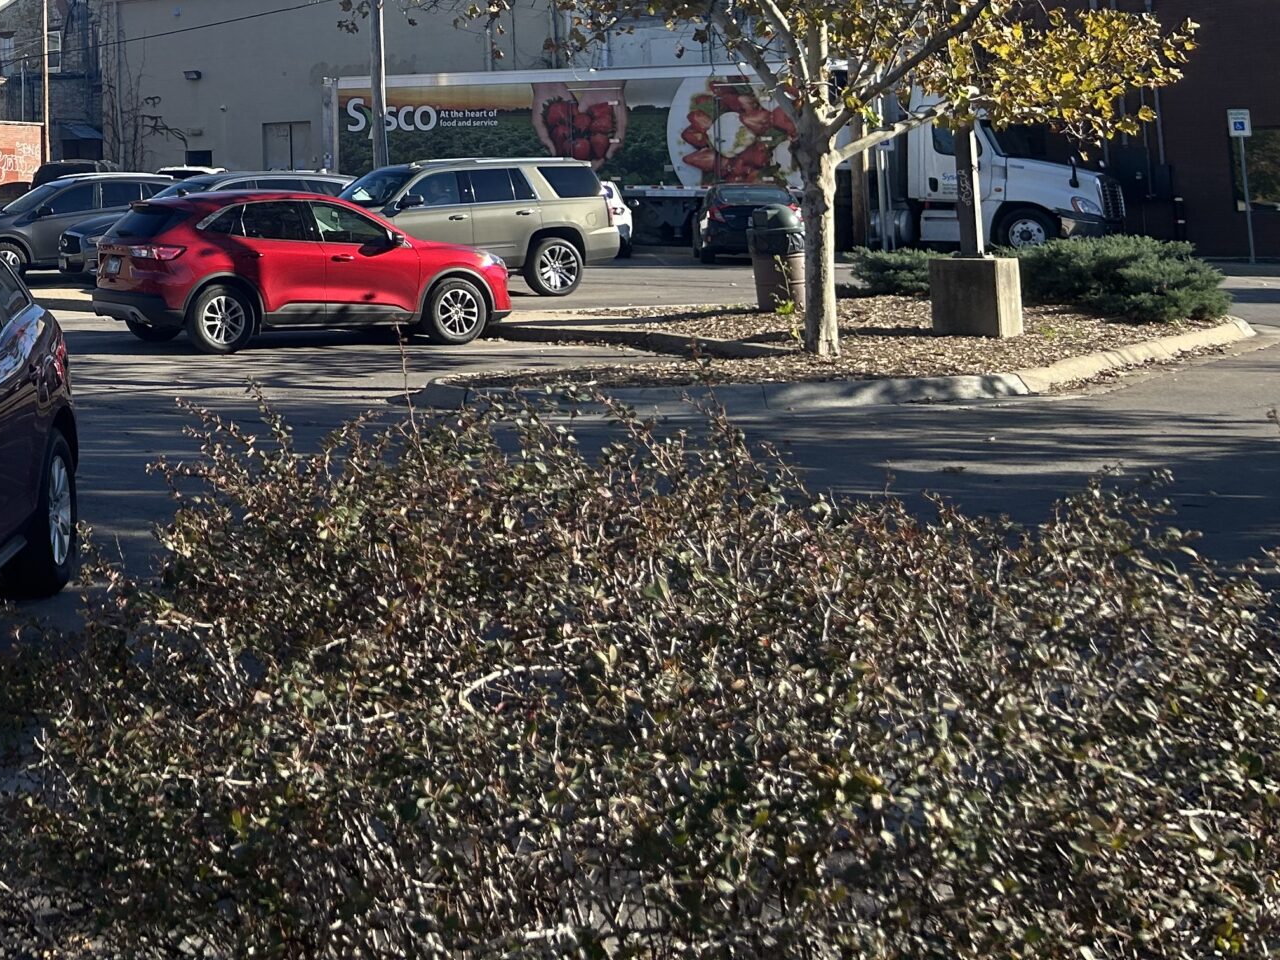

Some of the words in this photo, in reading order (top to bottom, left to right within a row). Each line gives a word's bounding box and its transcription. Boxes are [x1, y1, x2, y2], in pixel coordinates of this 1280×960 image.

[440, 110, 449, 118] At
[450, 110, 464, 118] the
[465, 109, 487, 118] heart
[488, 109, 497, 117] of
[440, 119, 456, 127] food
[457, 119, 471, 127] and
[472, 119, 498, 127] service
